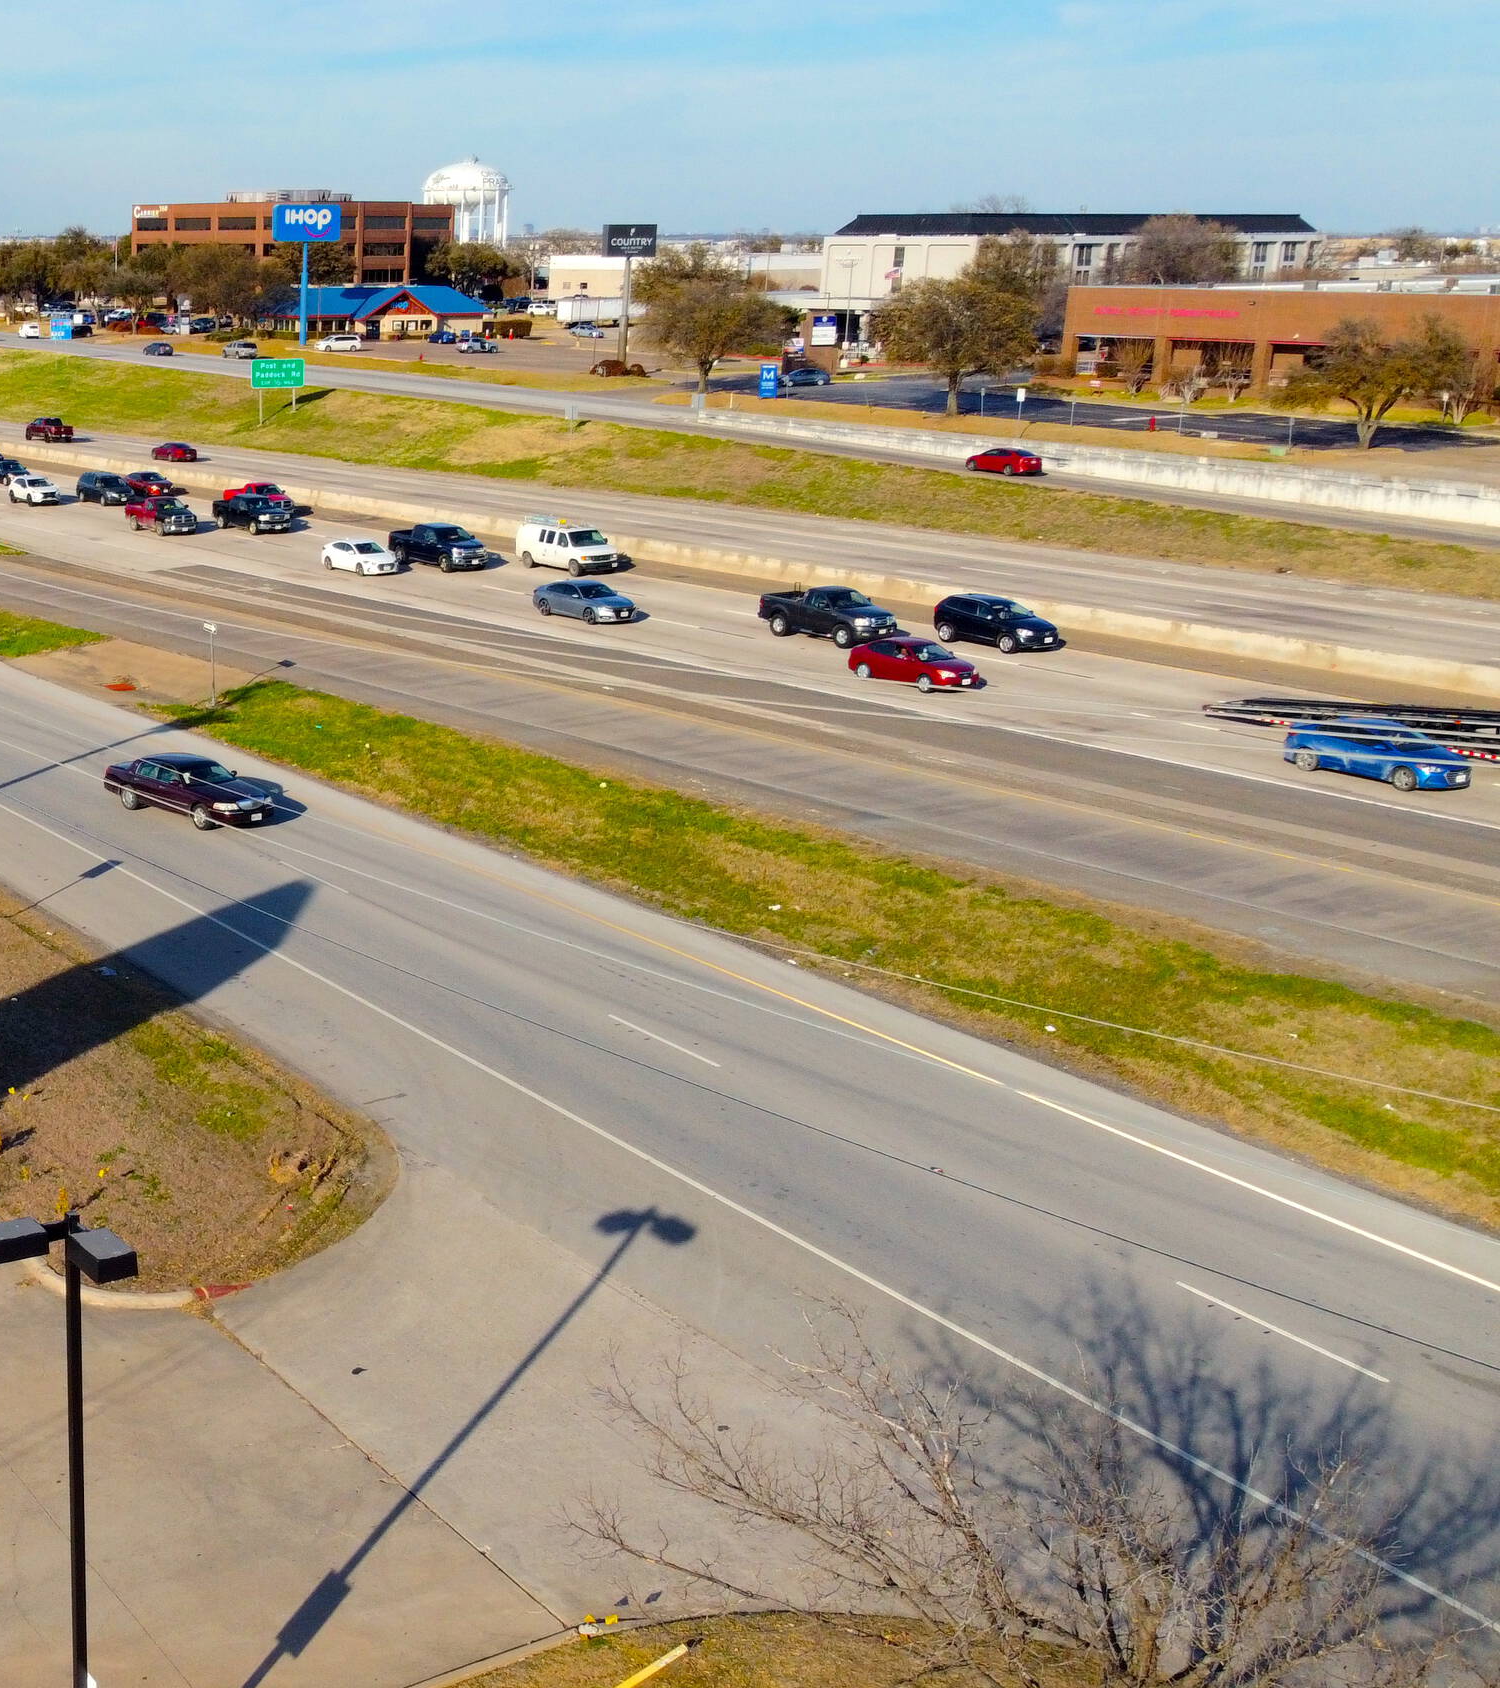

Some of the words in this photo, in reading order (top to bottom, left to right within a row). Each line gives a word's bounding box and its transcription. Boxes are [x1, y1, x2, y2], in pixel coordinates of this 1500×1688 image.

[285, 208, 332, 231] IHOP
[611, 237, 653, 246] COUNTRY
[282, 361, 296, 369] and
